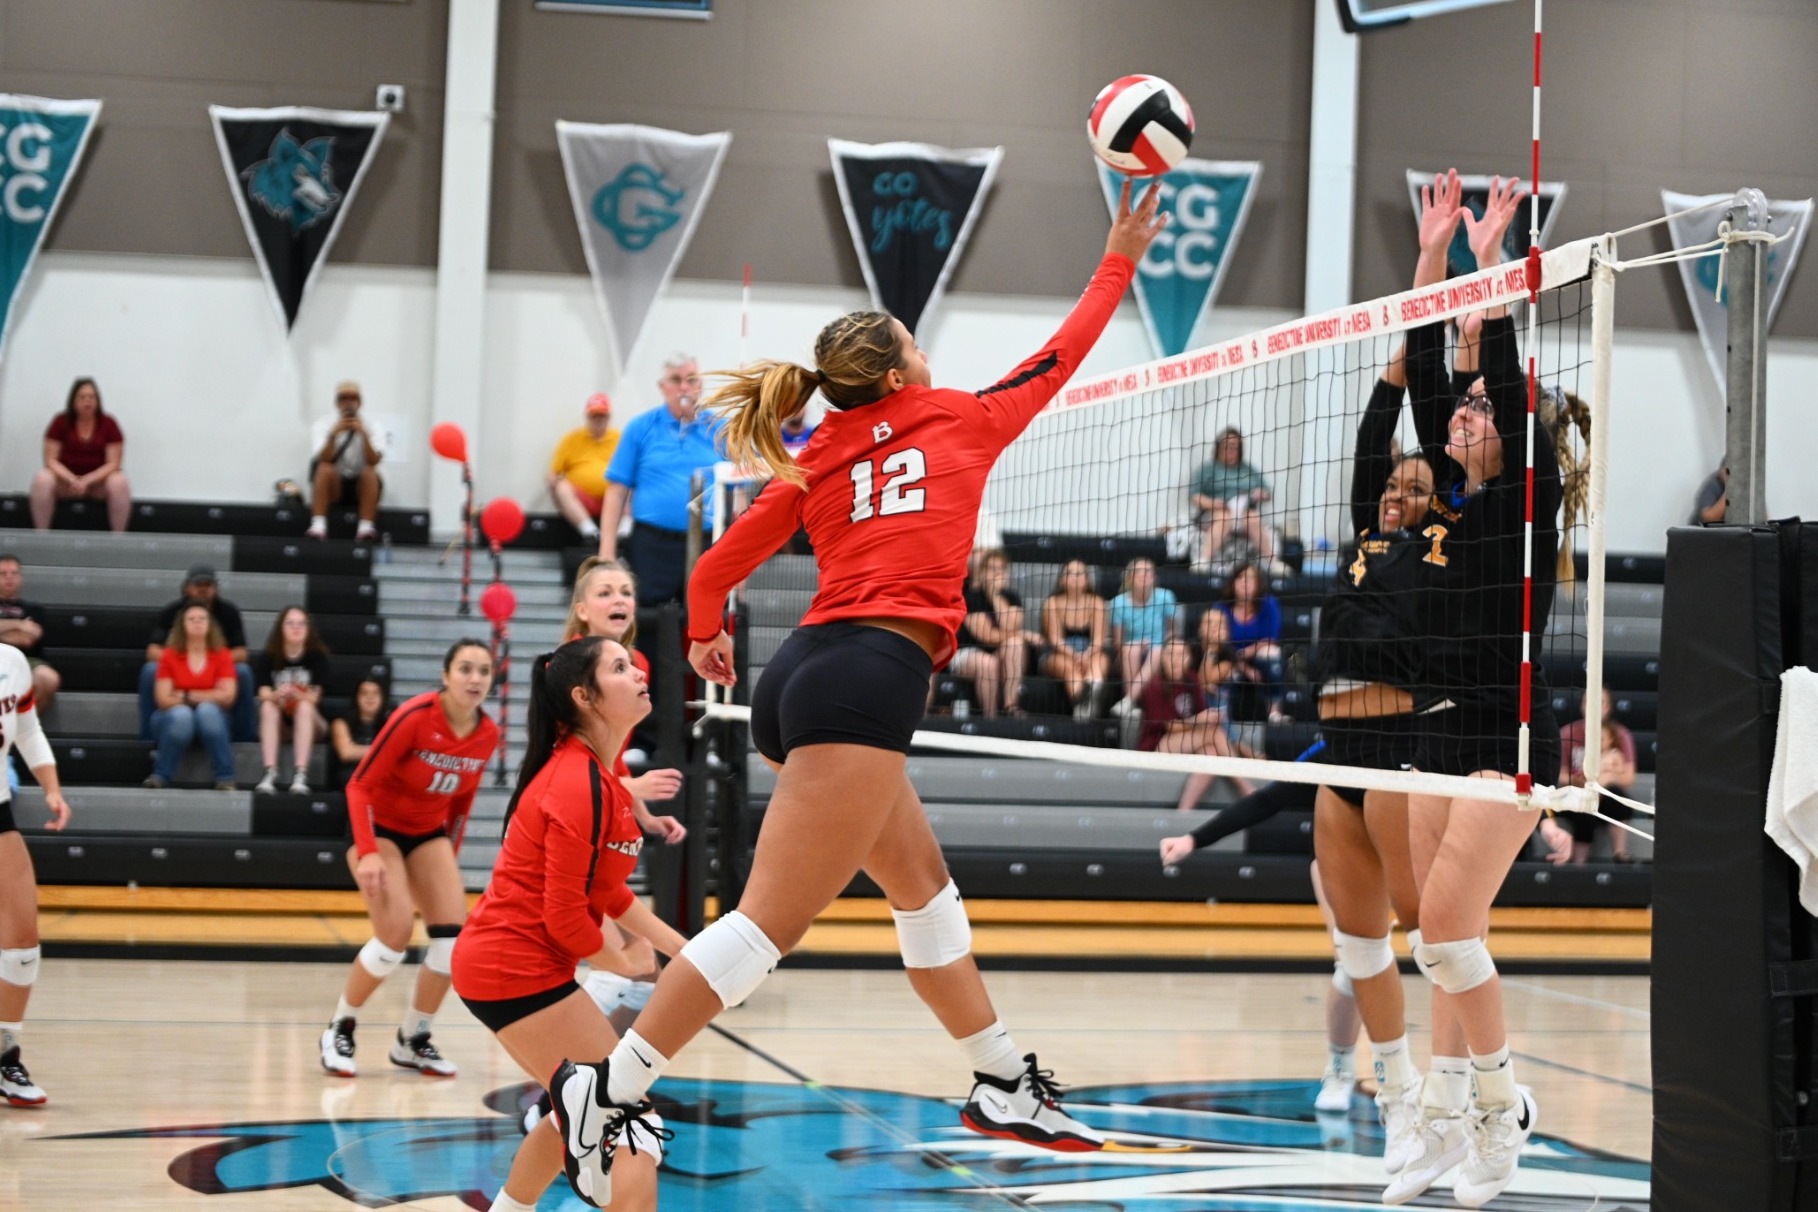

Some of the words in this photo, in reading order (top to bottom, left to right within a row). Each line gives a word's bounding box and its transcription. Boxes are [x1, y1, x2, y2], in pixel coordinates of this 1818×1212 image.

[0, 122, 53, 171] G
[0, 171, 47, 223] C
[1400, 290, 1447, 322] BENEDICTINE
[1448, 276, 1493, 310] UNIVERSITY
[1504, 267, 1526, 294] MES
[1267, 326, 1304, 355] BENEDICTINE
[1304, 316, 1342, 343] UNIVERSITY
[1351, 309, 1372, 333] MESA
[872, 421, 894, 445] B
[850, 447, 927, 523] 12
[1422, 524, 1449, 567] 2
[426, 769, 460, 795] 10
